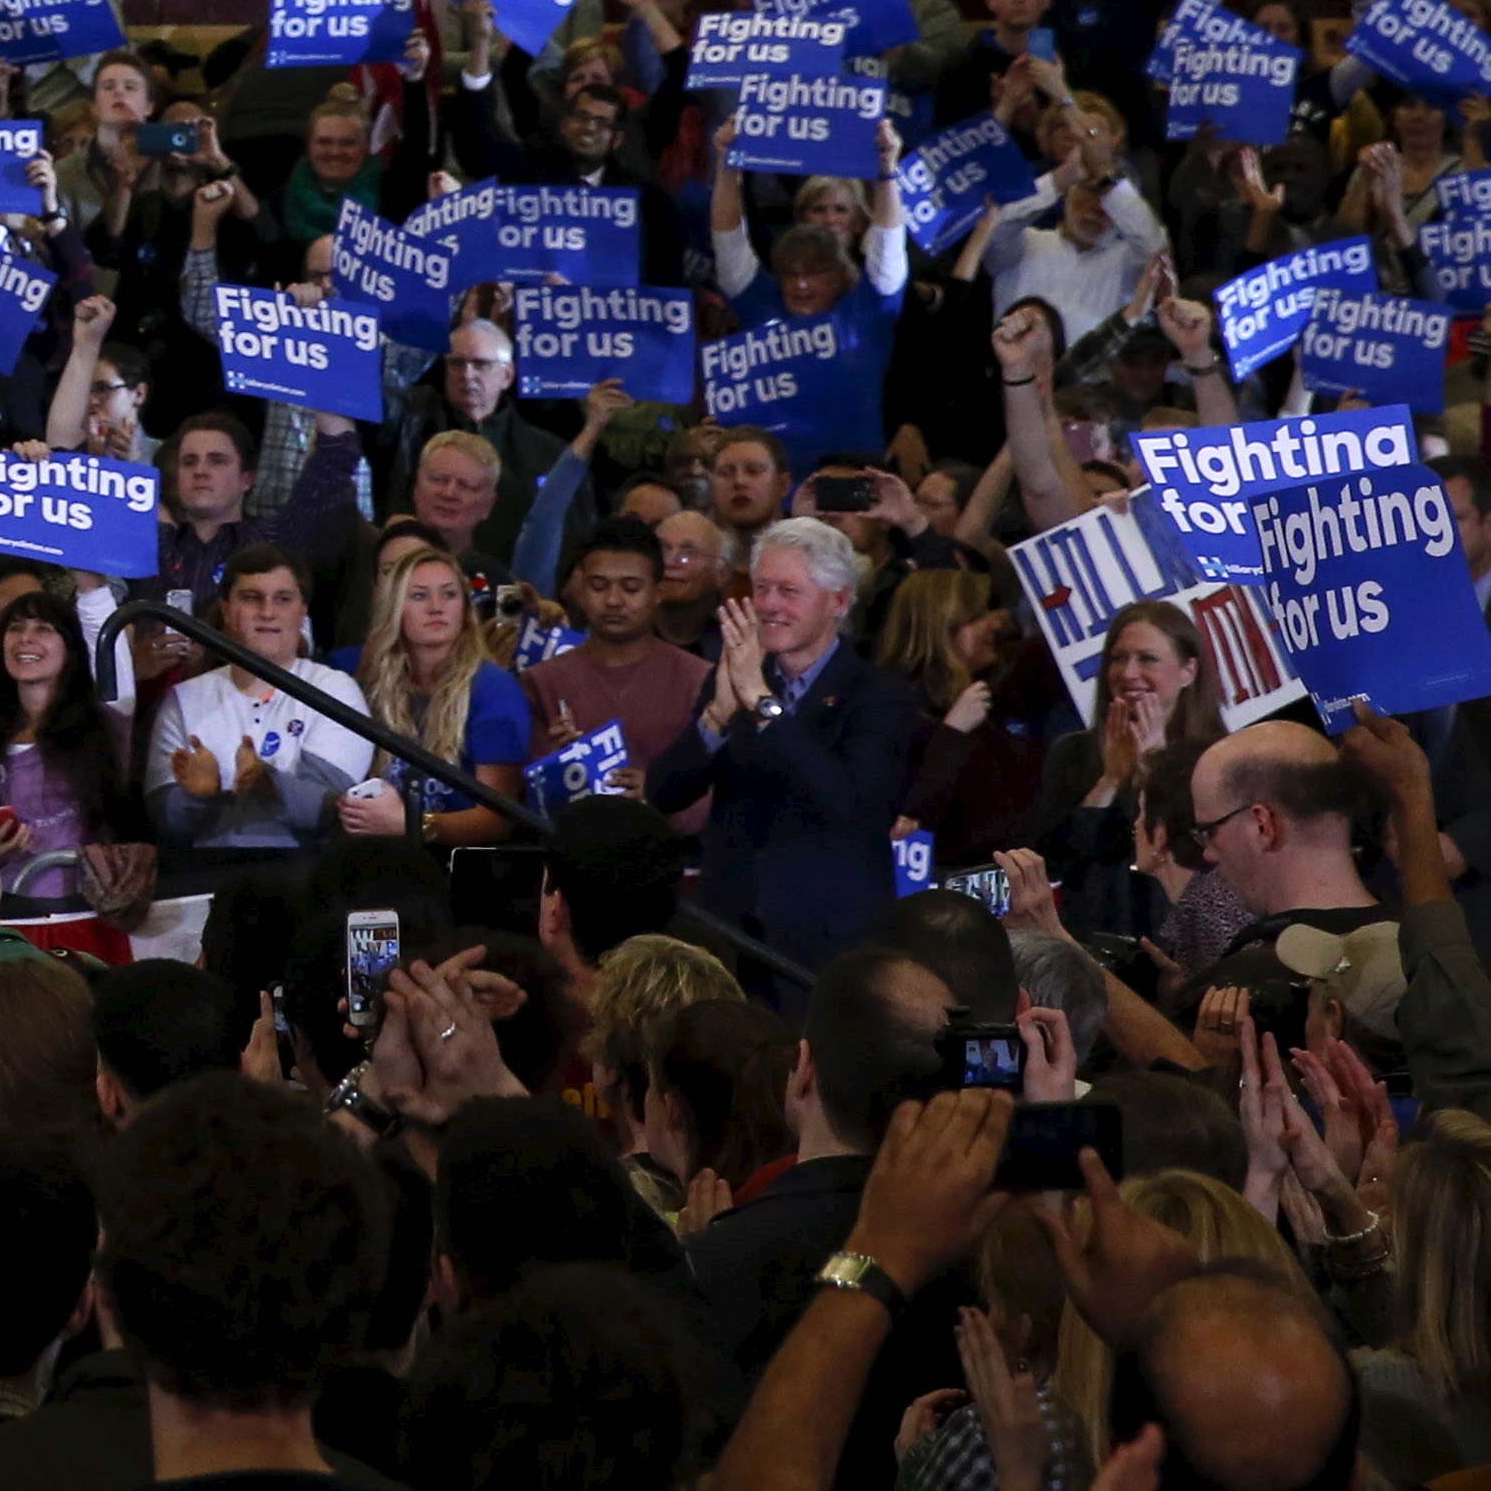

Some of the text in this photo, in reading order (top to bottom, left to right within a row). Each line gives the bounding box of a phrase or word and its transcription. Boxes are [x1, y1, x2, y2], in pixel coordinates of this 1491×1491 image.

[270, 10, 368, 38] for us
[516, 287, 690, 338] Fighting
[517, 323, 634, 358] for us
[42, 497, 92, 529] us
[1256, 477, 1453, 593] Fighting
[1271, 592, 1319, 653] for
[1328, 581, 1388, 639] us
